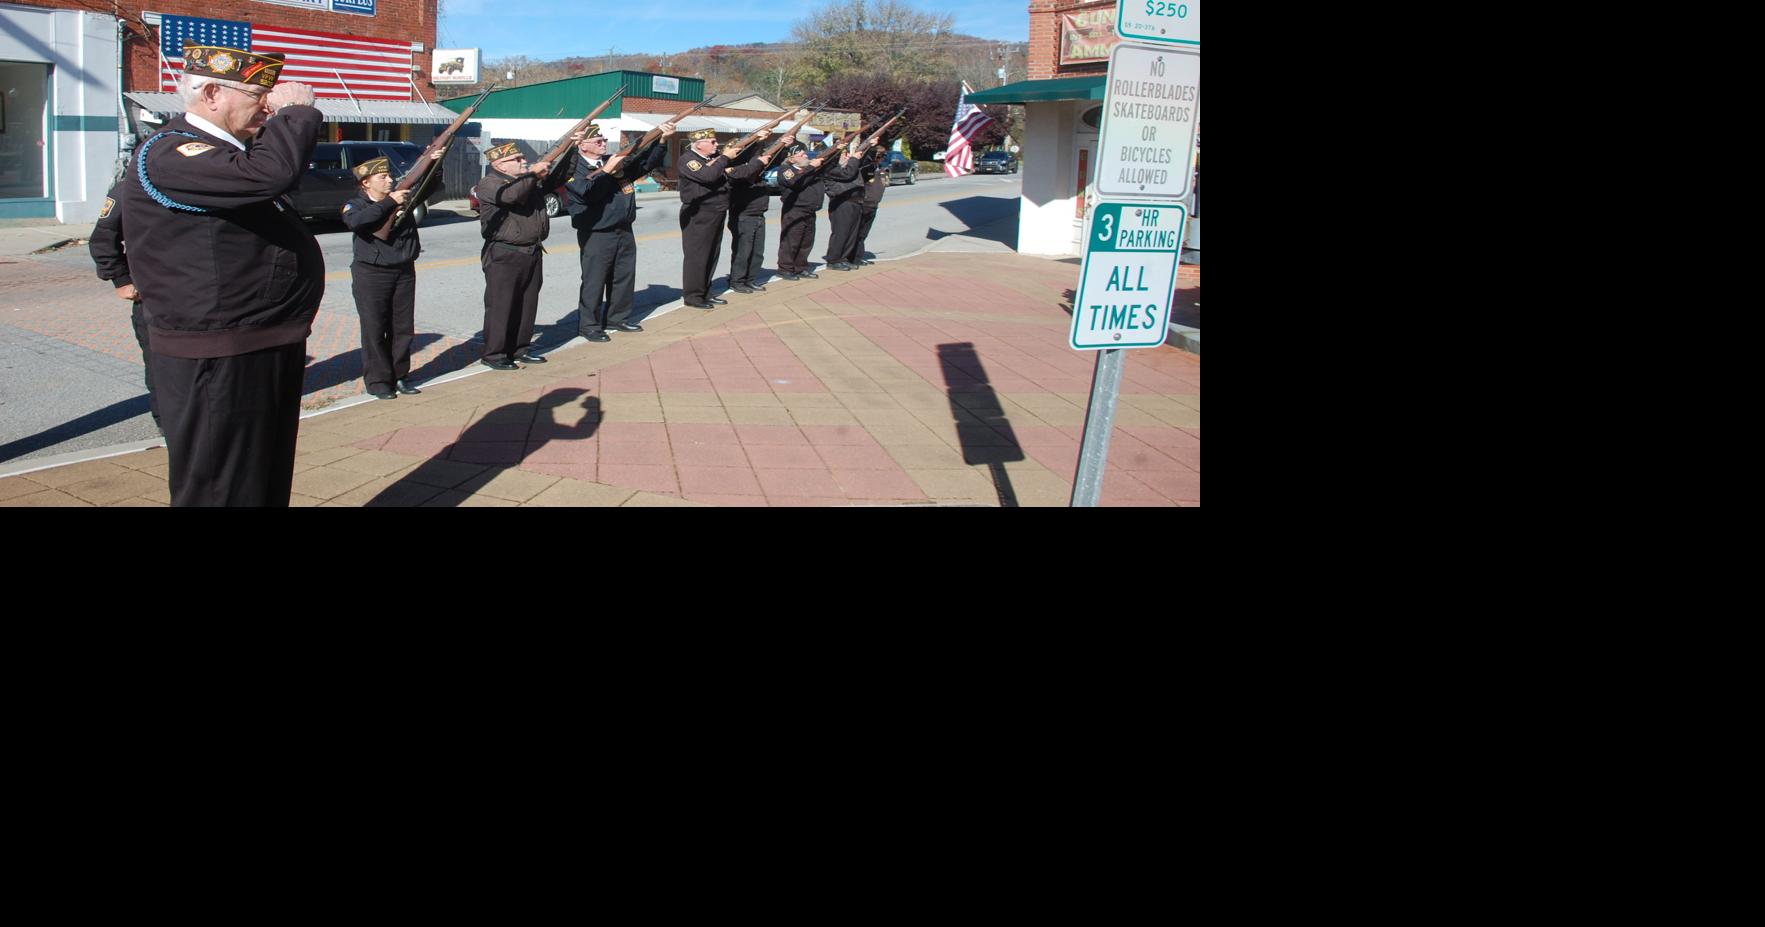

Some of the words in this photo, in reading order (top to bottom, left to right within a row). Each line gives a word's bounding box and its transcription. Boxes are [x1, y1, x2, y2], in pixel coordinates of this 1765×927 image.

[1145, 0, 1187, 18] $250
[1149, 61, 1166, 77] NO
[1114, 80, 1195, 101] ROLLERBLADES
[1113, 102, 1190, 122] SKATEBOARDS
[1141, 125, 1157, 141] OR
[1120, 146, 1172, 164] BICYCLES
[1118, 168, 1168, 184] ALLOWED
[1141, 209, 1160, 227] HR
[1098, 214, 1114, 241] 3
[1119, 230, 1176, 248] PARKING
[1105, 266, 1149, 291] ALL
[1090, 304, 1158, 331] TIMES
